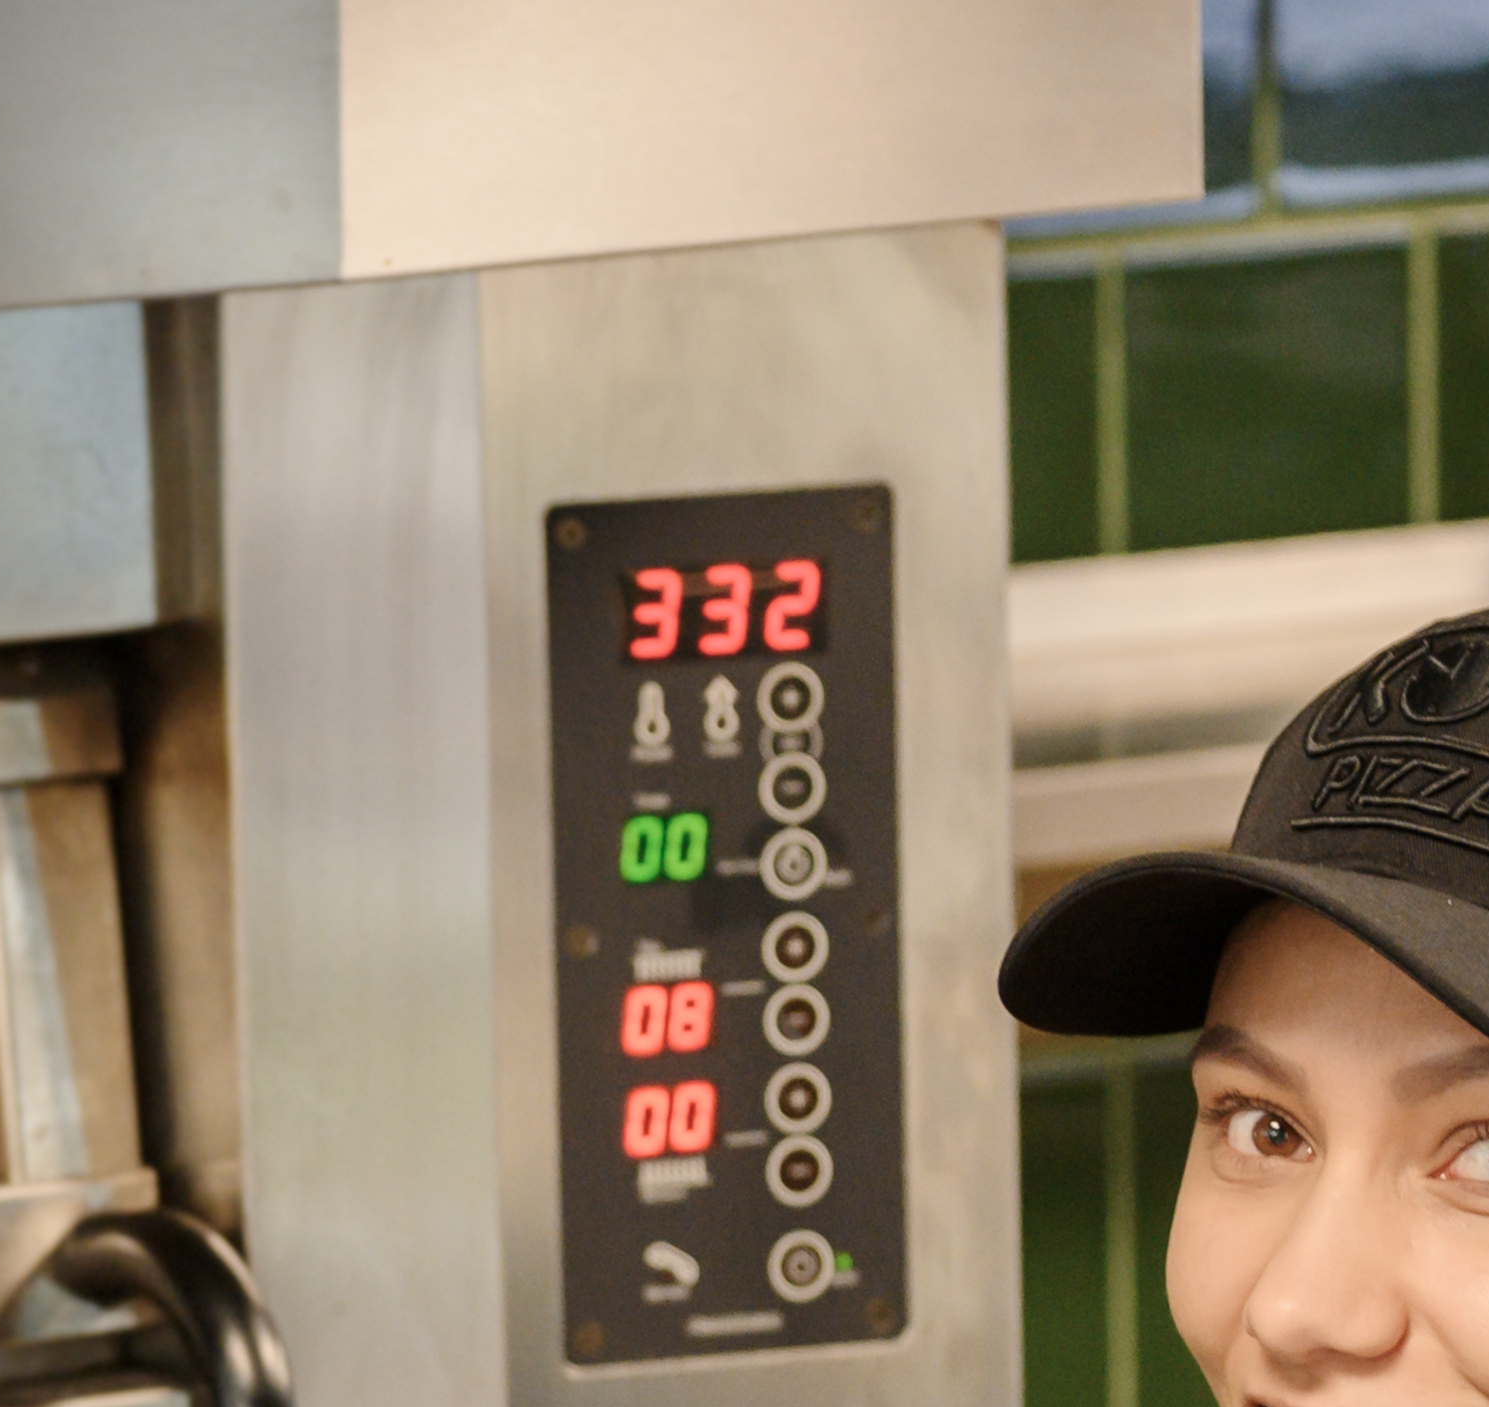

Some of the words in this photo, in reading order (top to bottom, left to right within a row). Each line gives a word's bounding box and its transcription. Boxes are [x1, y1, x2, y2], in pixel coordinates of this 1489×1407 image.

[630, 559, 821, 659] 332
[619, 811, 710, 884] 00
[620, 979, 715, 1058] 08
[621, 1079, 718, 1161] 00
